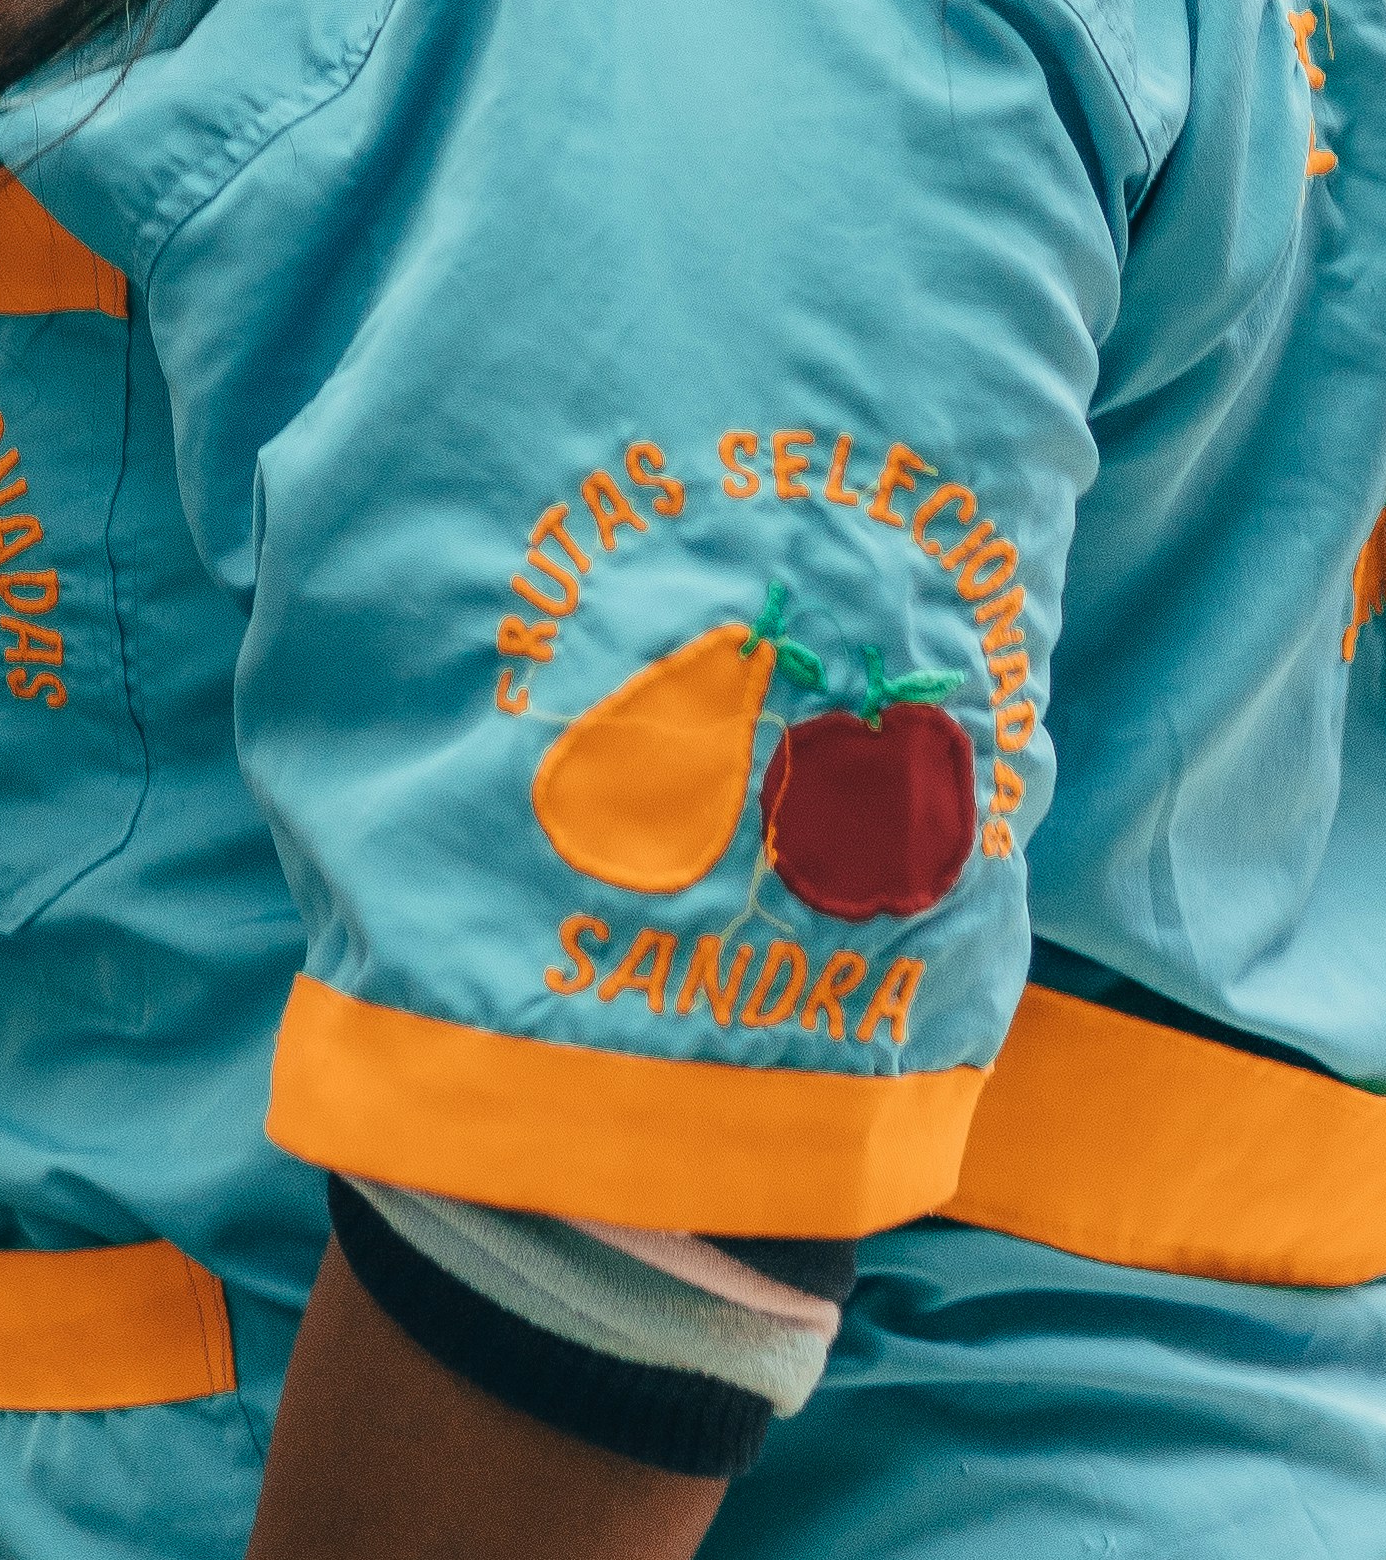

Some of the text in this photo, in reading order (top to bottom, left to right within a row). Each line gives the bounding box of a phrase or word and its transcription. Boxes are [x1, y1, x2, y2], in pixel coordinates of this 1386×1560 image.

[495, 438, 686, 717] FRUTAS
[717, 429, 1038, 860] SELECIONADAS
[543, 913, 927, 1045] SANDRA
